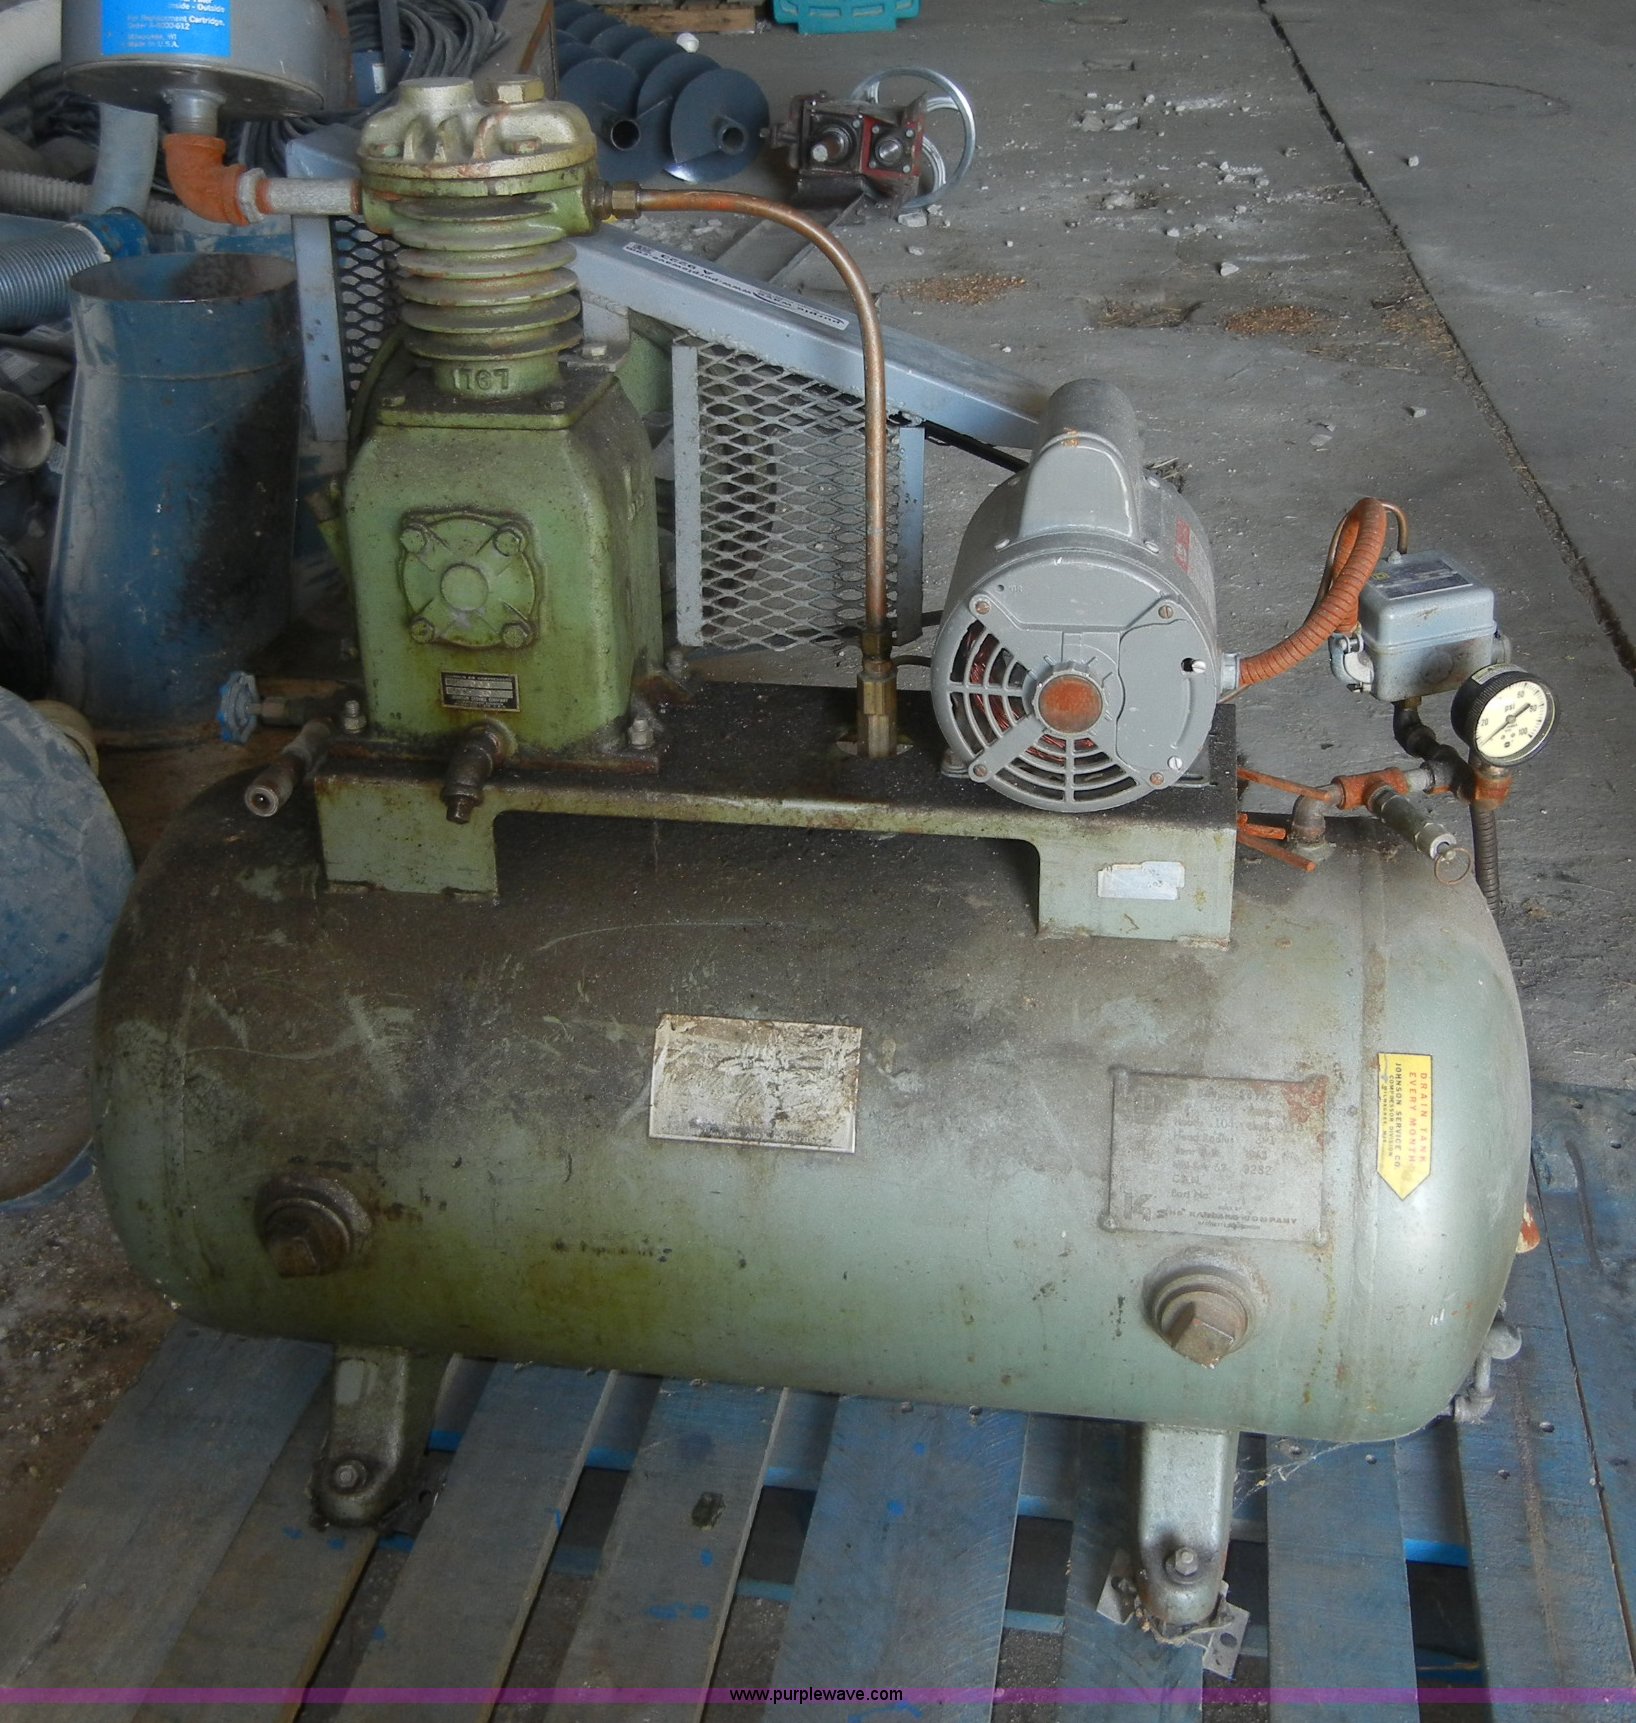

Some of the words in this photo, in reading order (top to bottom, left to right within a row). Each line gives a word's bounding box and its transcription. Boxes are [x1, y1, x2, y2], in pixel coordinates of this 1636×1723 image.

[197, 4, 225, 13] Outside
[1505, 703, 1515, 712] psi
[1480, 718, 1489, 726] 20
[1518, 727, 1528, 736] 100
[1409, 1071, 1417, 1111] EVERY
[1420, 1072, 1428, 1117] DRAIN
[1408, 1118, 1416, 1162] MONTH
